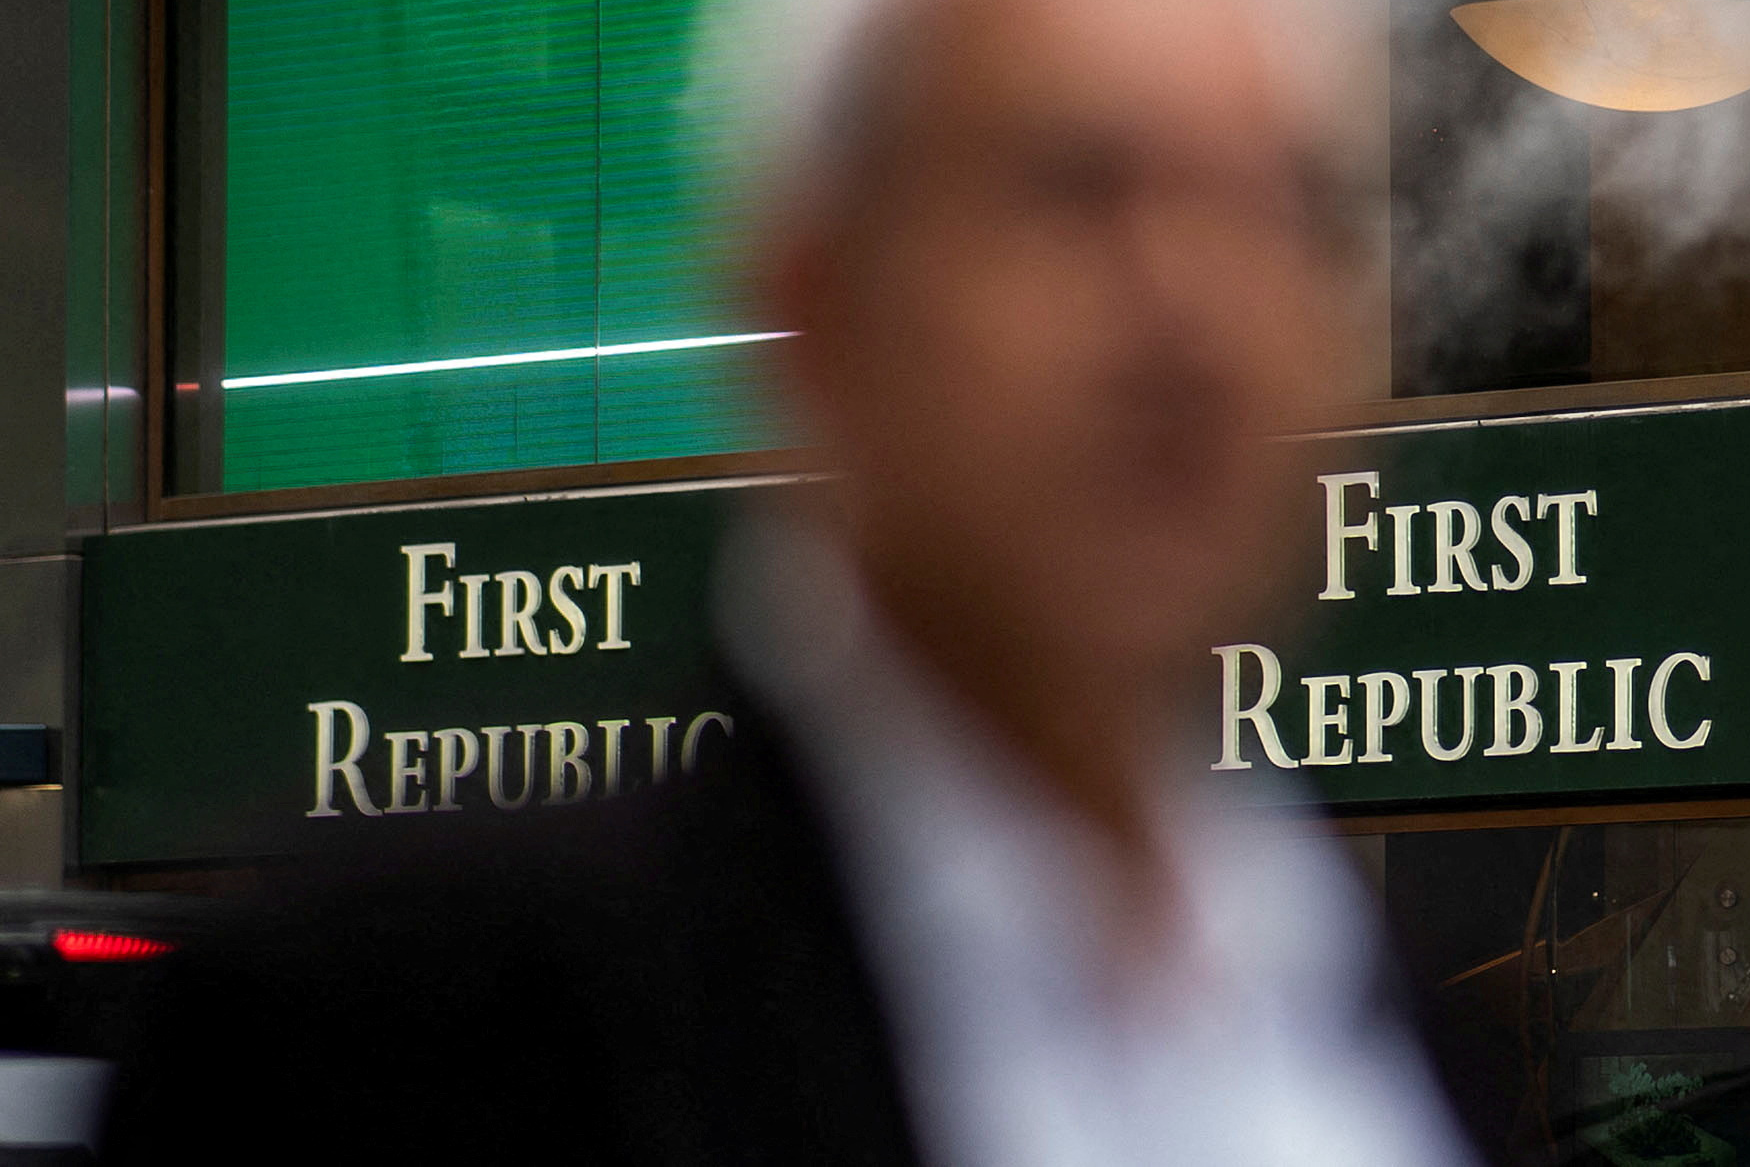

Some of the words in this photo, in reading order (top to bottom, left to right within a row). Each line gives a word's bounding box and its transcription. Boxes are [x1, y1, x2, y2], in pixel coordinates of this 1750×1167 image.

[1316, 470, 1598, 601] FIRST
[400, 542, 641, 663] FIRST
[1210, 642, 1712, 771] REPUBLIC
